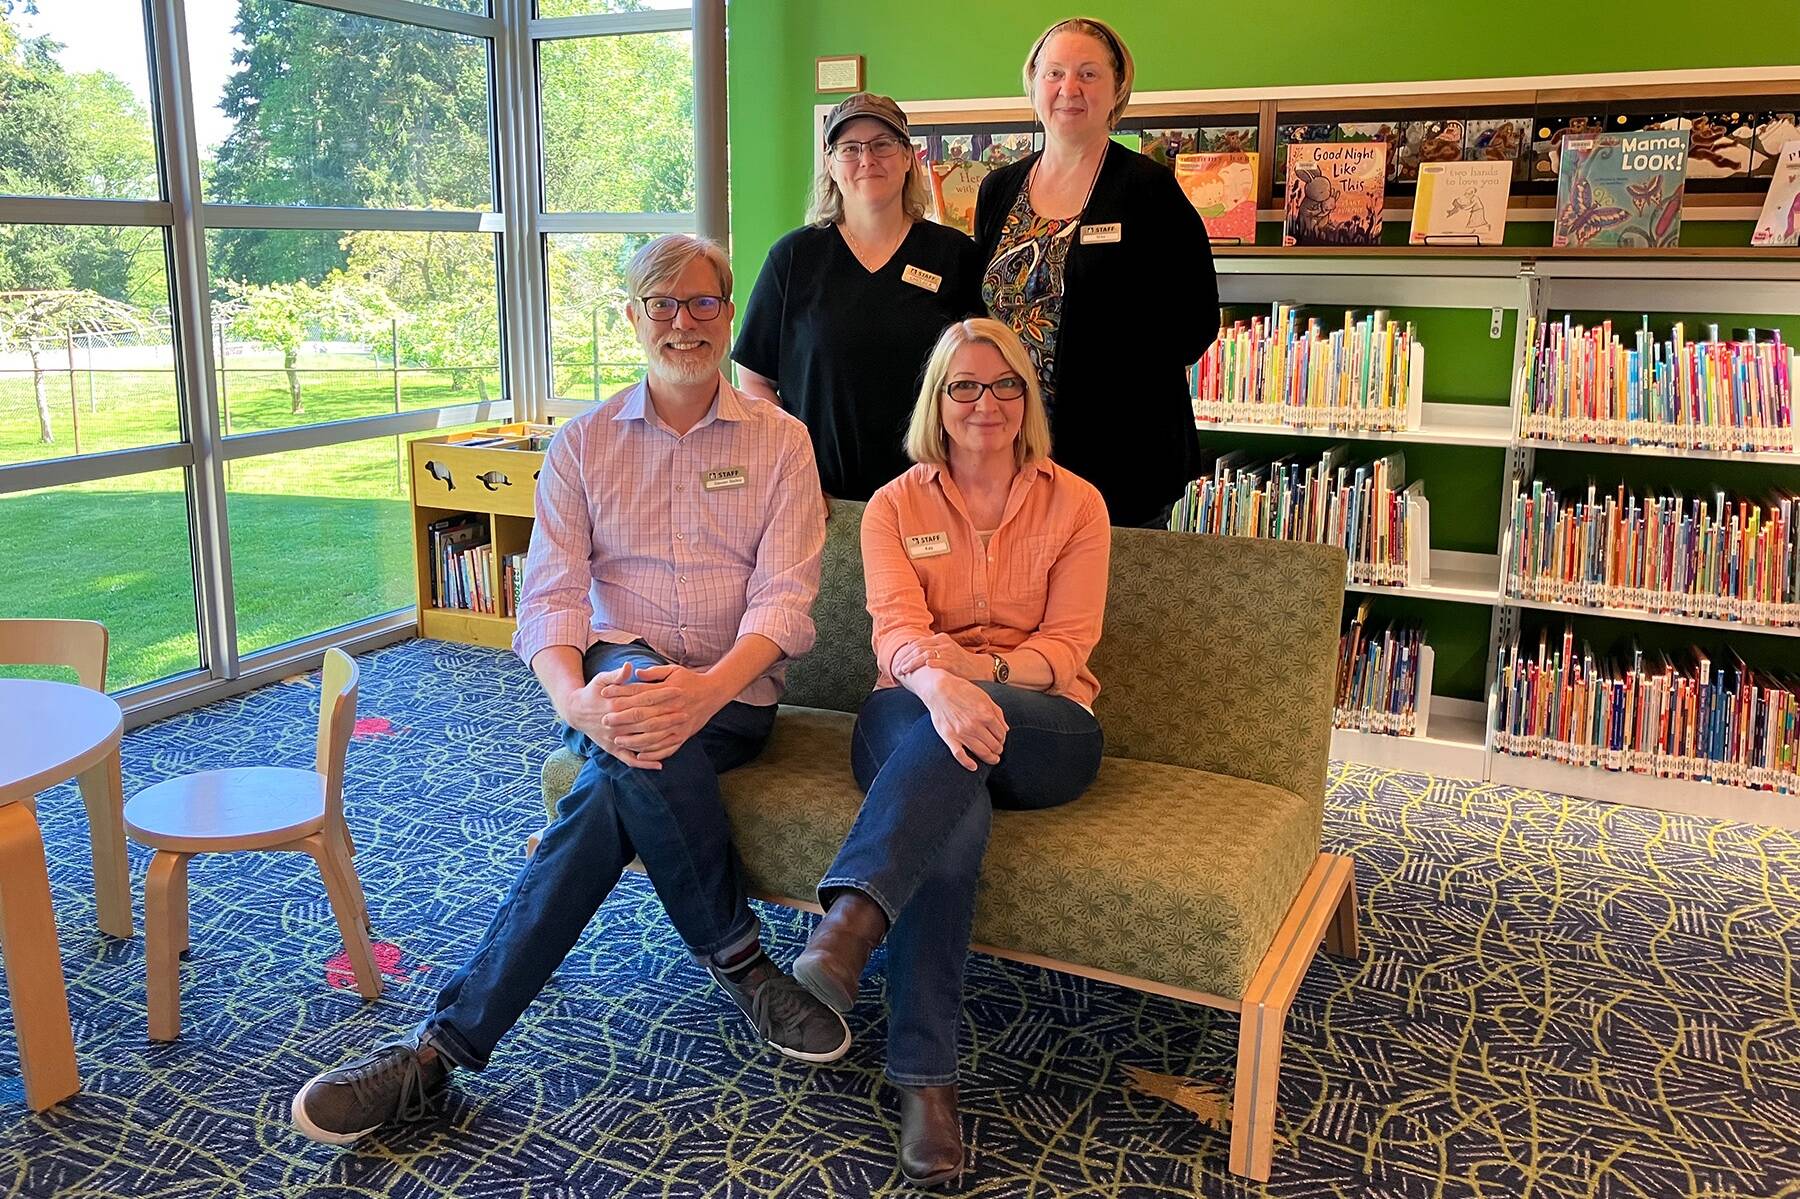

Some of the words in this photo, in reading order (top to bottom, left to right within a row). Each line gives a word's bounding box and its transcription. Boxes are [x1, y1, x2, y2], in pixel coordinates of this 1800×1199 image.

[1621, 137, 1686, 152] Mama,
[1313, 147, 1343, 161] Good
[1345, 147, 1374, 165] Night
[1621, 152, 1684, 171] LOOK!
[1333, 163, 1357, 178] Like
[1449, 168, 1468, 177] two
[1470, 166, 1498, 177] hands
[1339, 178, 1365, 192] This
[1446, 178, 1456, 186] to
[1458, 177, 1478, 186] love
[1480, 178, 1499, 188] you
[955, 185, 975, 193] with
[918, 270, 936, 281] STAFF
[718, 470, 739, 478] STAFF
[920, 534, 940, 544] STAFF
